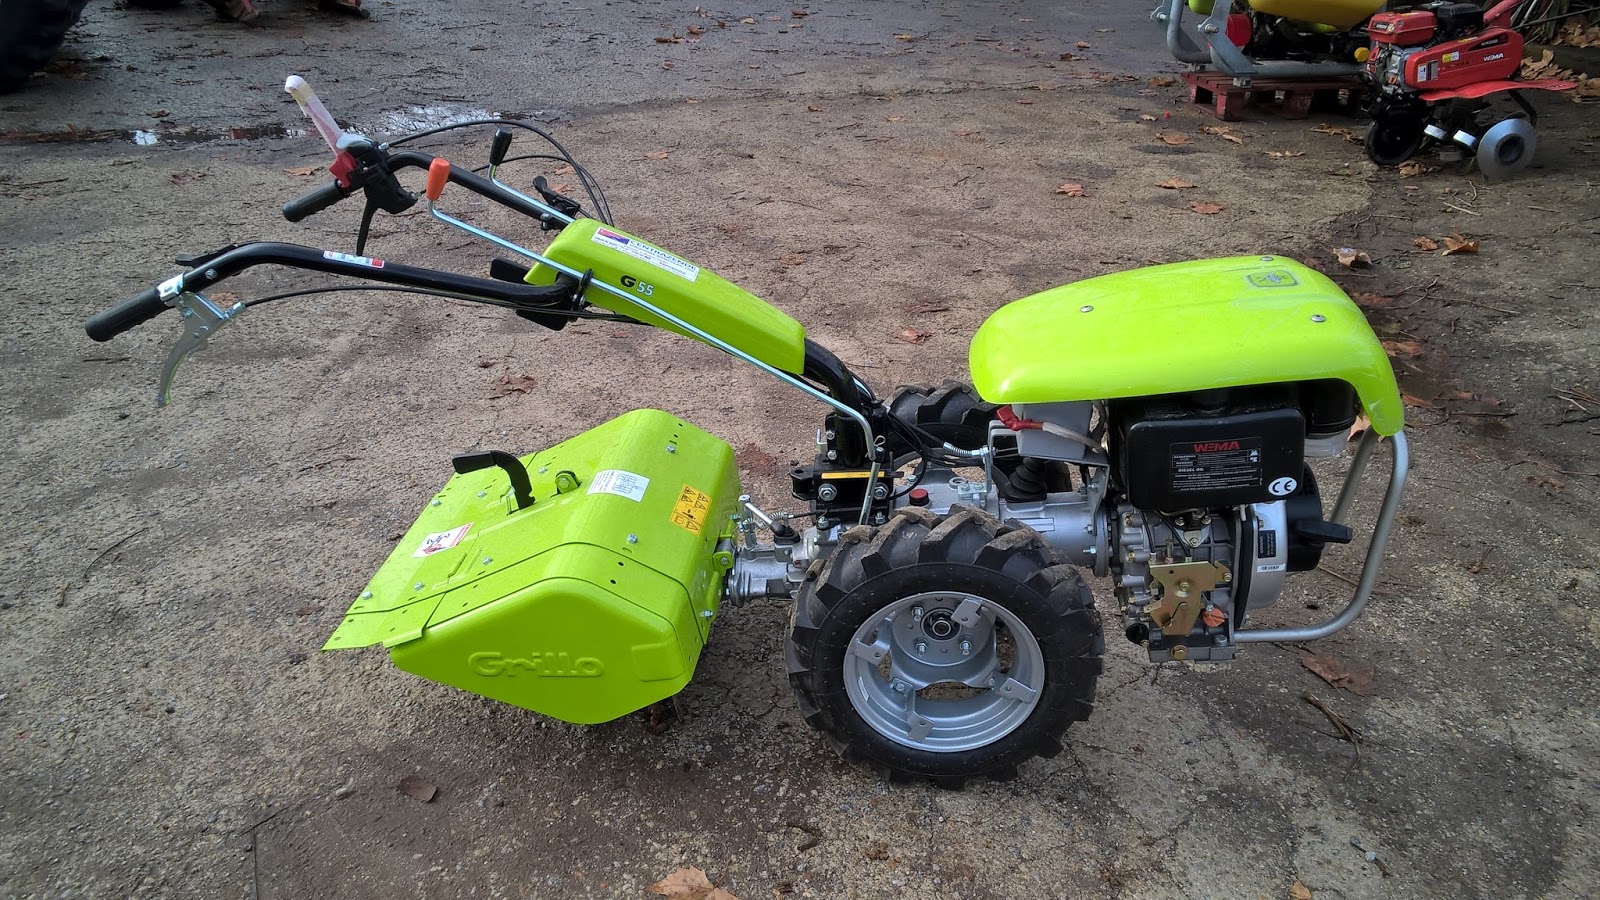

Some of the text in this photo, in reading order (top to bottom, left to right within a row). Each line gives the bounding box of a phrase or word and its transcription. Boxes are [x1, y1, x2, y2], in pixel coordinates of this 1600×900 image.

[1484, 53, 1503, 61] WEMA
[1194, 441, 1240, 453] WEMA
[468, 650, 605, 677] Grillo
